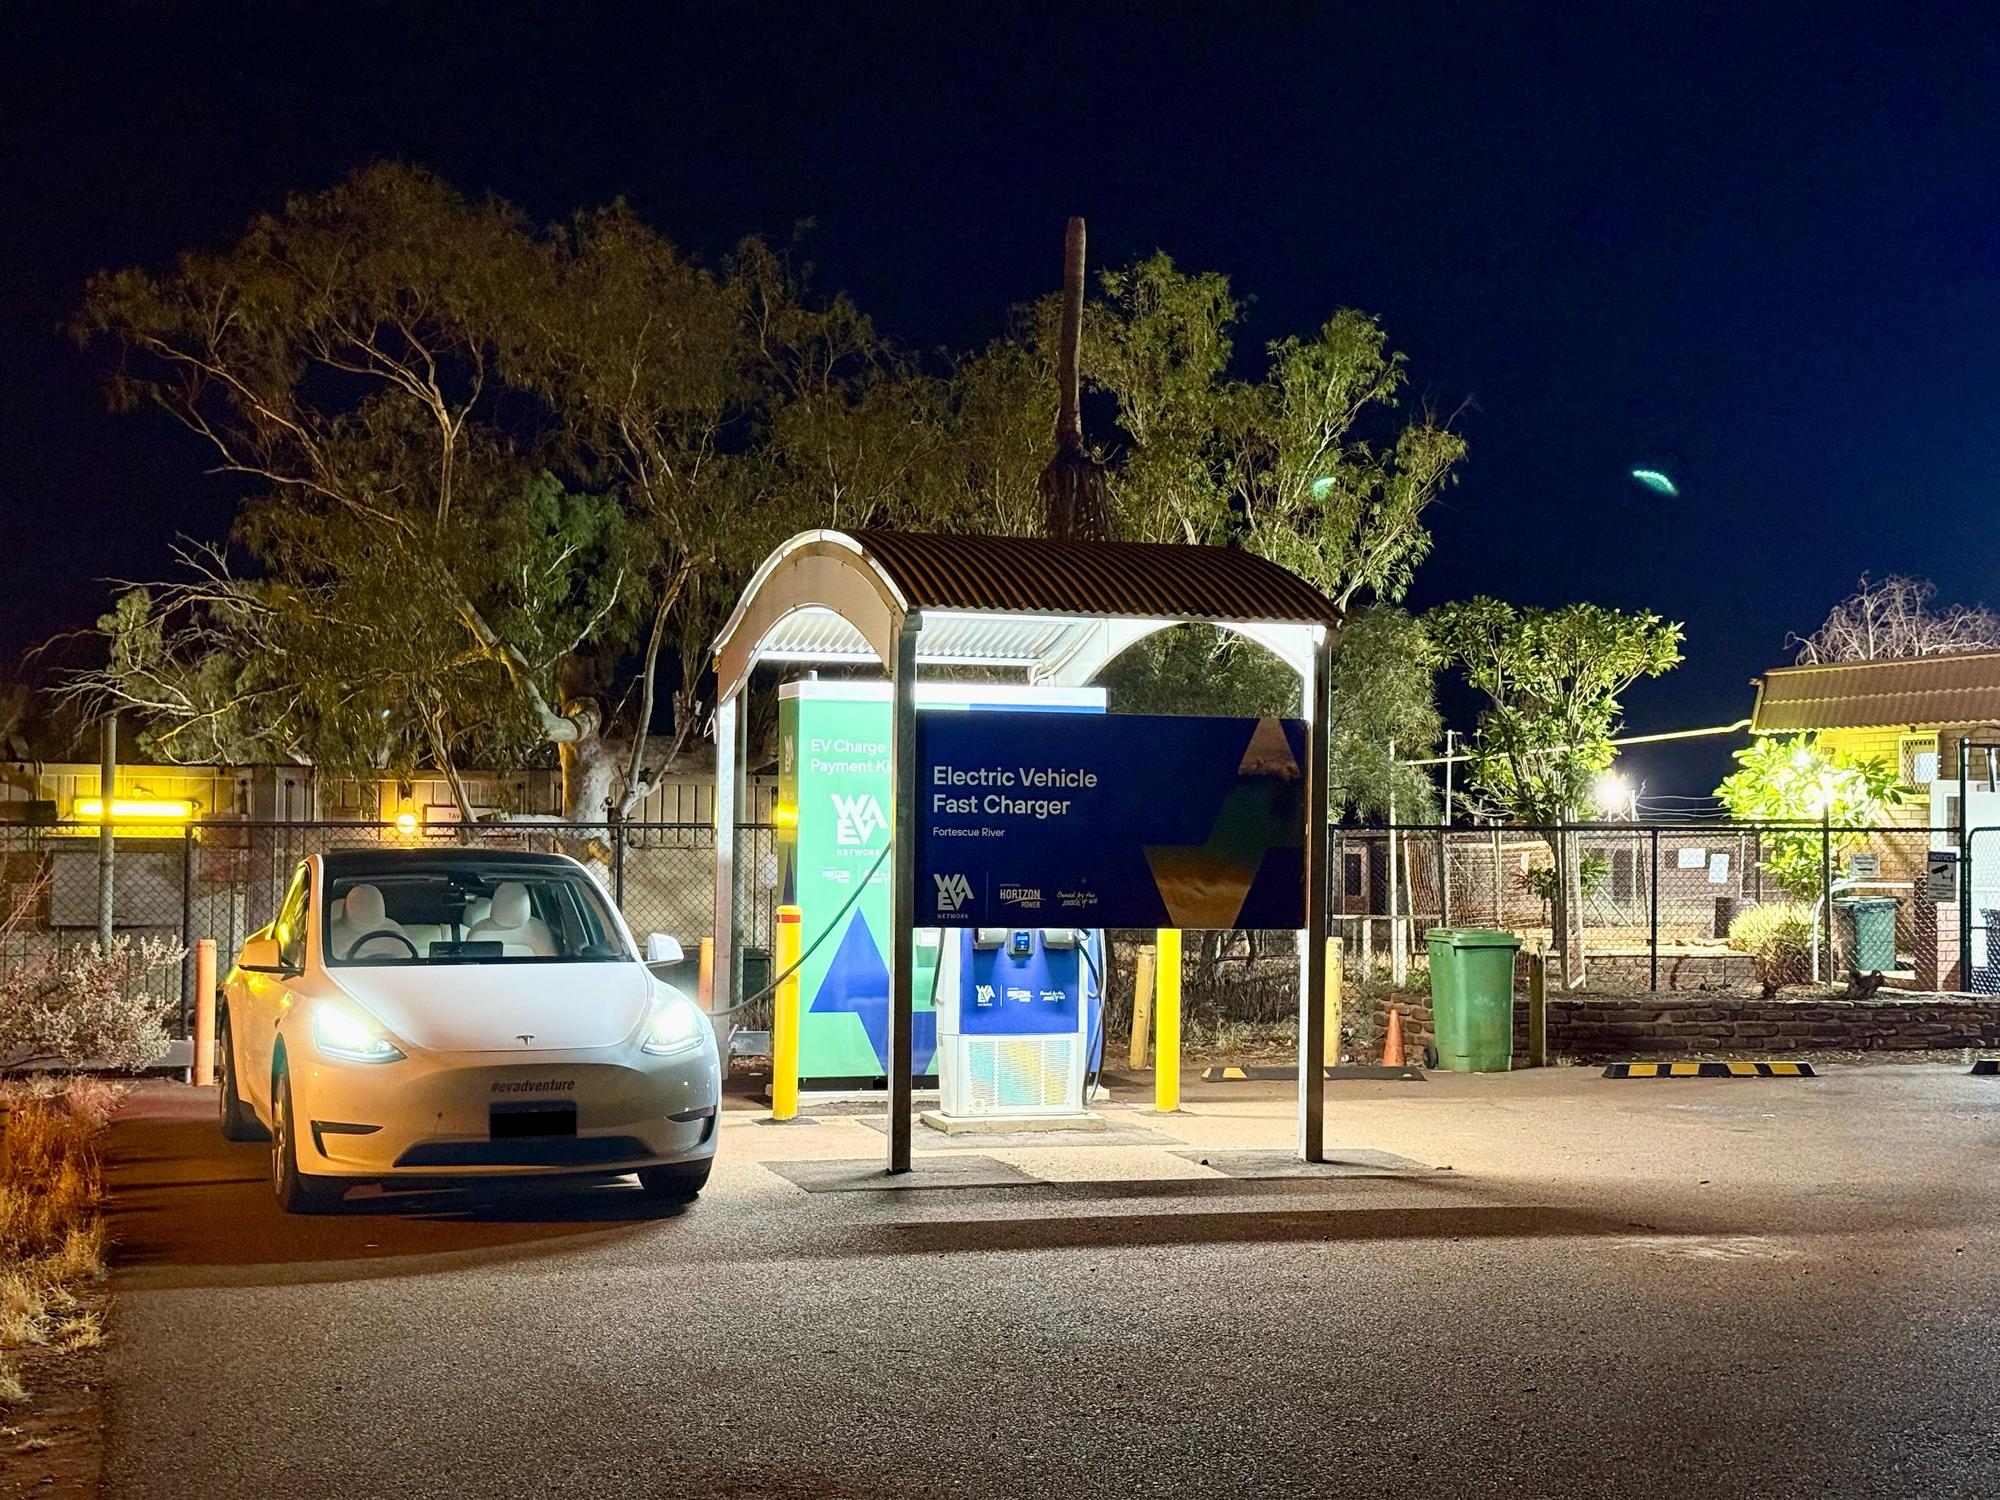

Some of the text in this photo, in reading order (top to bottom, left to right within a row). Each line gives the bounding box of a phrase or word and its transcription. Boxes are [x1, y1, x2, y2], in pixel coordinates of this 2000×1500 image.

[810, 738, 886, 757] EV Charge
[810, 758, 873, 775] Payment
[933, 766, 1098, 788] Electric Vehicle
[933, 793, 1071, 820] Fast Charger
[932, 826, 1005, 837] Fortescue River
[837, 848, 880, 857] NETWORK
[1000, 889, 1040, 900] HORIZON
[491, 1079, 575, 1093] #evadventure
